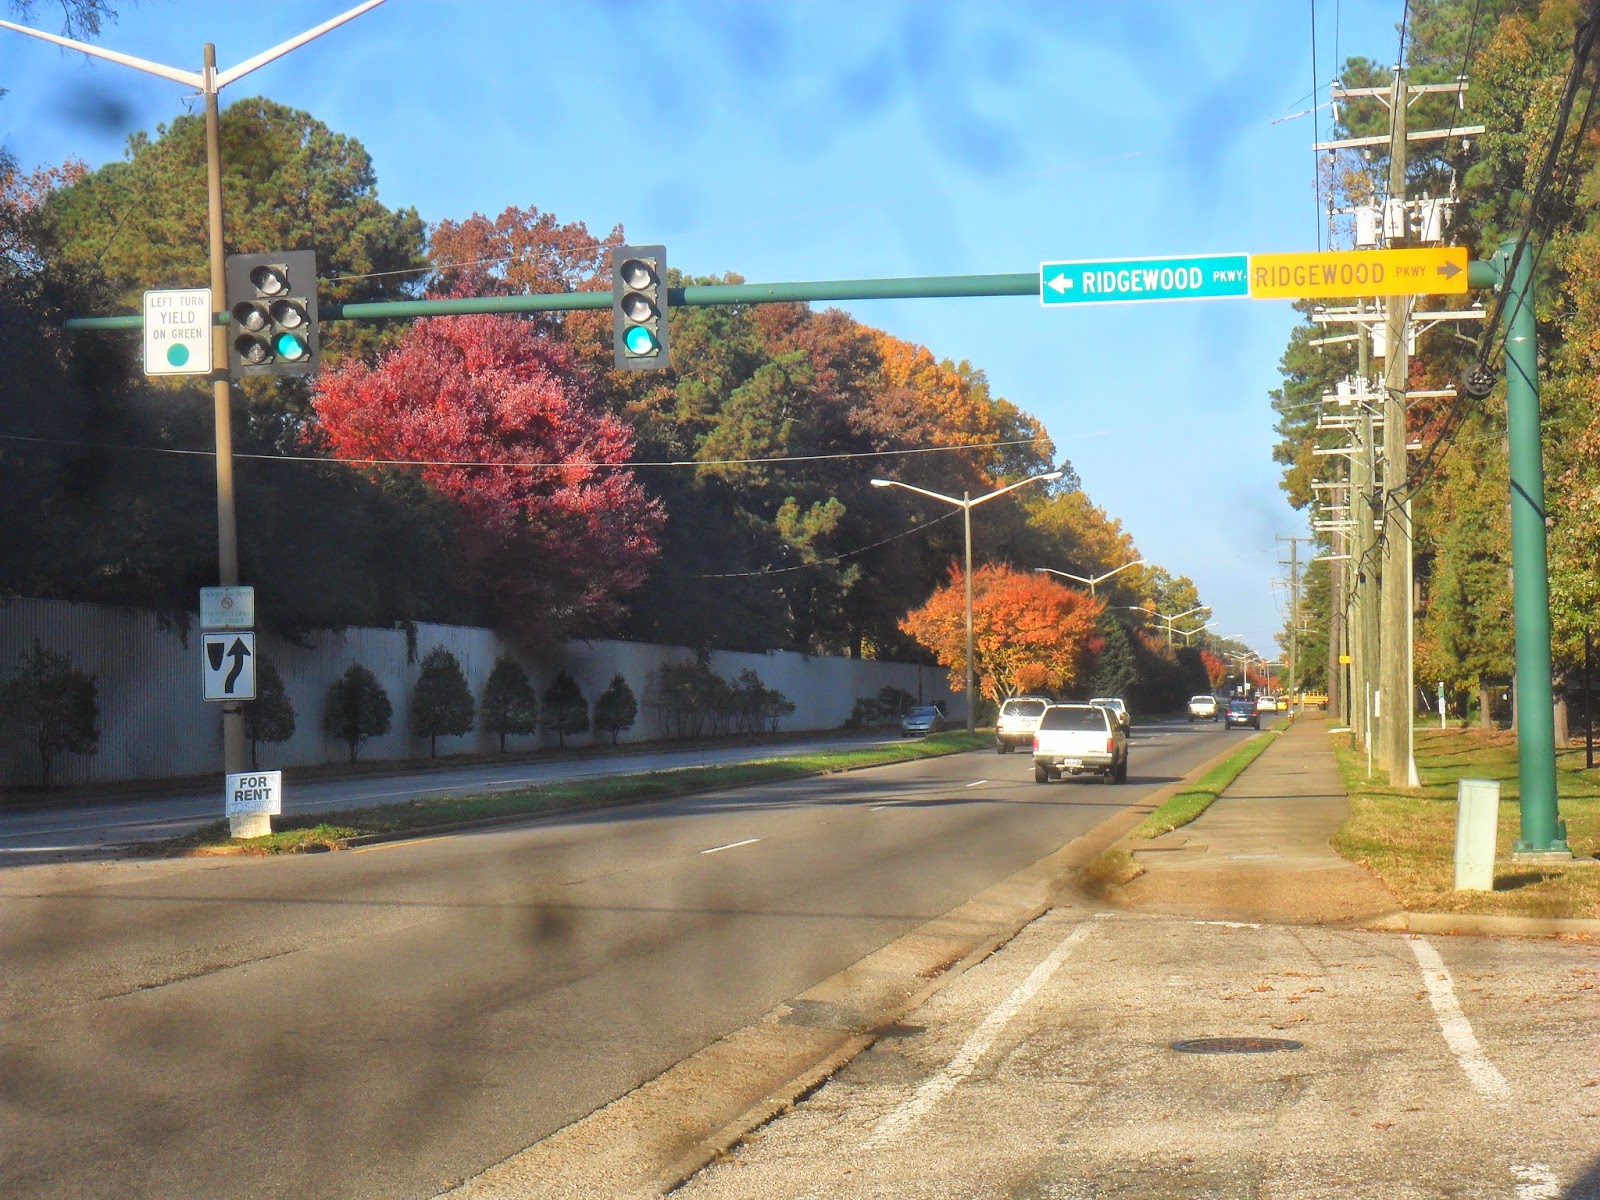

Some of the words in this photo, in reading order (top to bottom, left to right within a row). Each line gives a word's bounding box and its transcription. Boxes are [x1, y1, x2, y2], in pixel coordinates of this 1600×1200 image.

[1082, 266, 1203, 294] RIDGEWOOD
[1212, 269, 1244, 283] PKWY
[1255, 263, 1385, 288] RIDGEWOOD
[1396, 265, 1427, 278] PKWY
[151, 297, 173, 308] LEFT
[180, 296, 204, 306] TURN
[160, 311, 196, 325] YIELD
[153, 329, 166, 340] ON
[171, 328, 202, 339] GREEN
[240, 776, 267, 789] FOR
[234, 788, 272, 802] RENT
